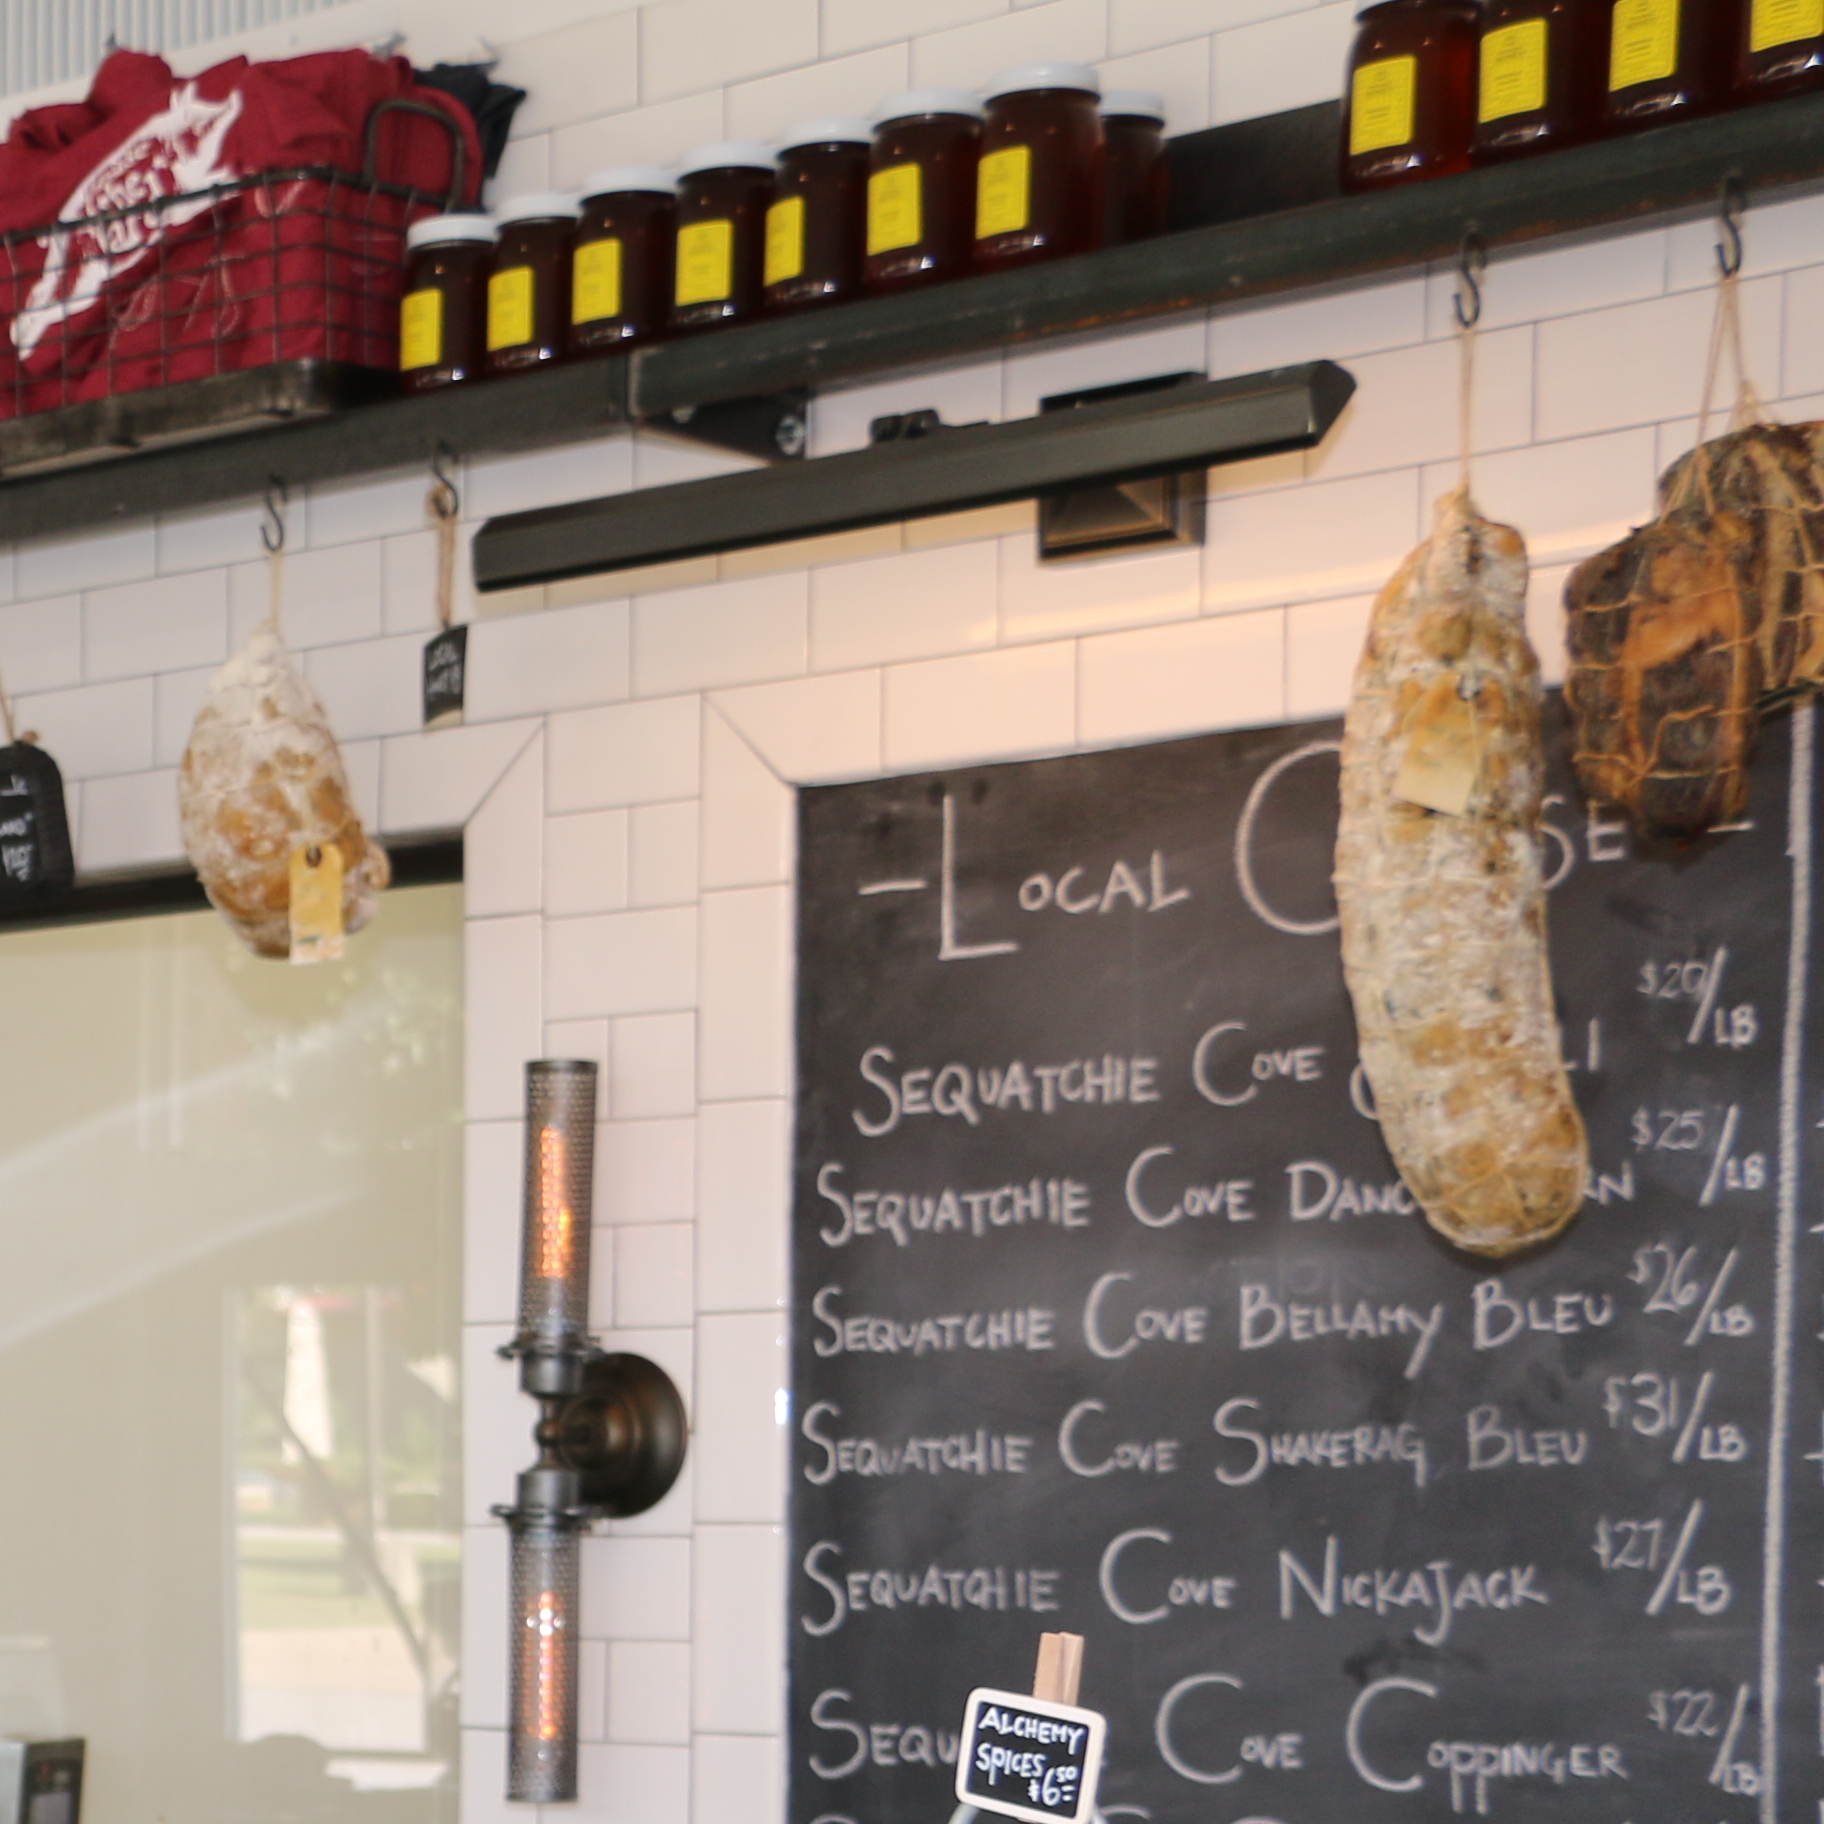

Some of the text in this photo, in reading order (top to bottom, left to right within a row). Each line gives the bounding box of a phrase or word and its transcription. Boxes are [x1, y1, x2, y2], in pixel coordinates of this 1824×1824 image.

[852, 1046, 1159, 1136] SEQUATCHIE
[1192, 1021, 1324, 1107] COVE
[816, 1162, 1090, 1246] SEQUATCHIE
[1125, 1146, 1254, 1229] COVE
[813, 1286, 1055, 1358] SEQUATCHIE
[1083, 1272, 1209, 1357] COVE
[1240, 1285, 1444, 1379] BELLAMY
[1474, 1280, 1614, 1351] BLEU
[802, 1402, 1033, 1485] SEQUATCHIE
[1058, 1399, 1180, 1480] COVE
[1213, 1398, 1427, 1488] SHAKERAG
[1467, 1407, 1588, 1468] BLEU
[802, 1541, 1061, 1637] SEQUATCHIE
[1099, 1528, 1236, 1625] COVE
[1278, 1537, 1548, 1645] NICKAJACK
[975, 1742, 1047, 1786] SPICES
[978, 1706, 1085, 1756] ALCHEMY
[1156, 1673, 1303, 1784] COVE
